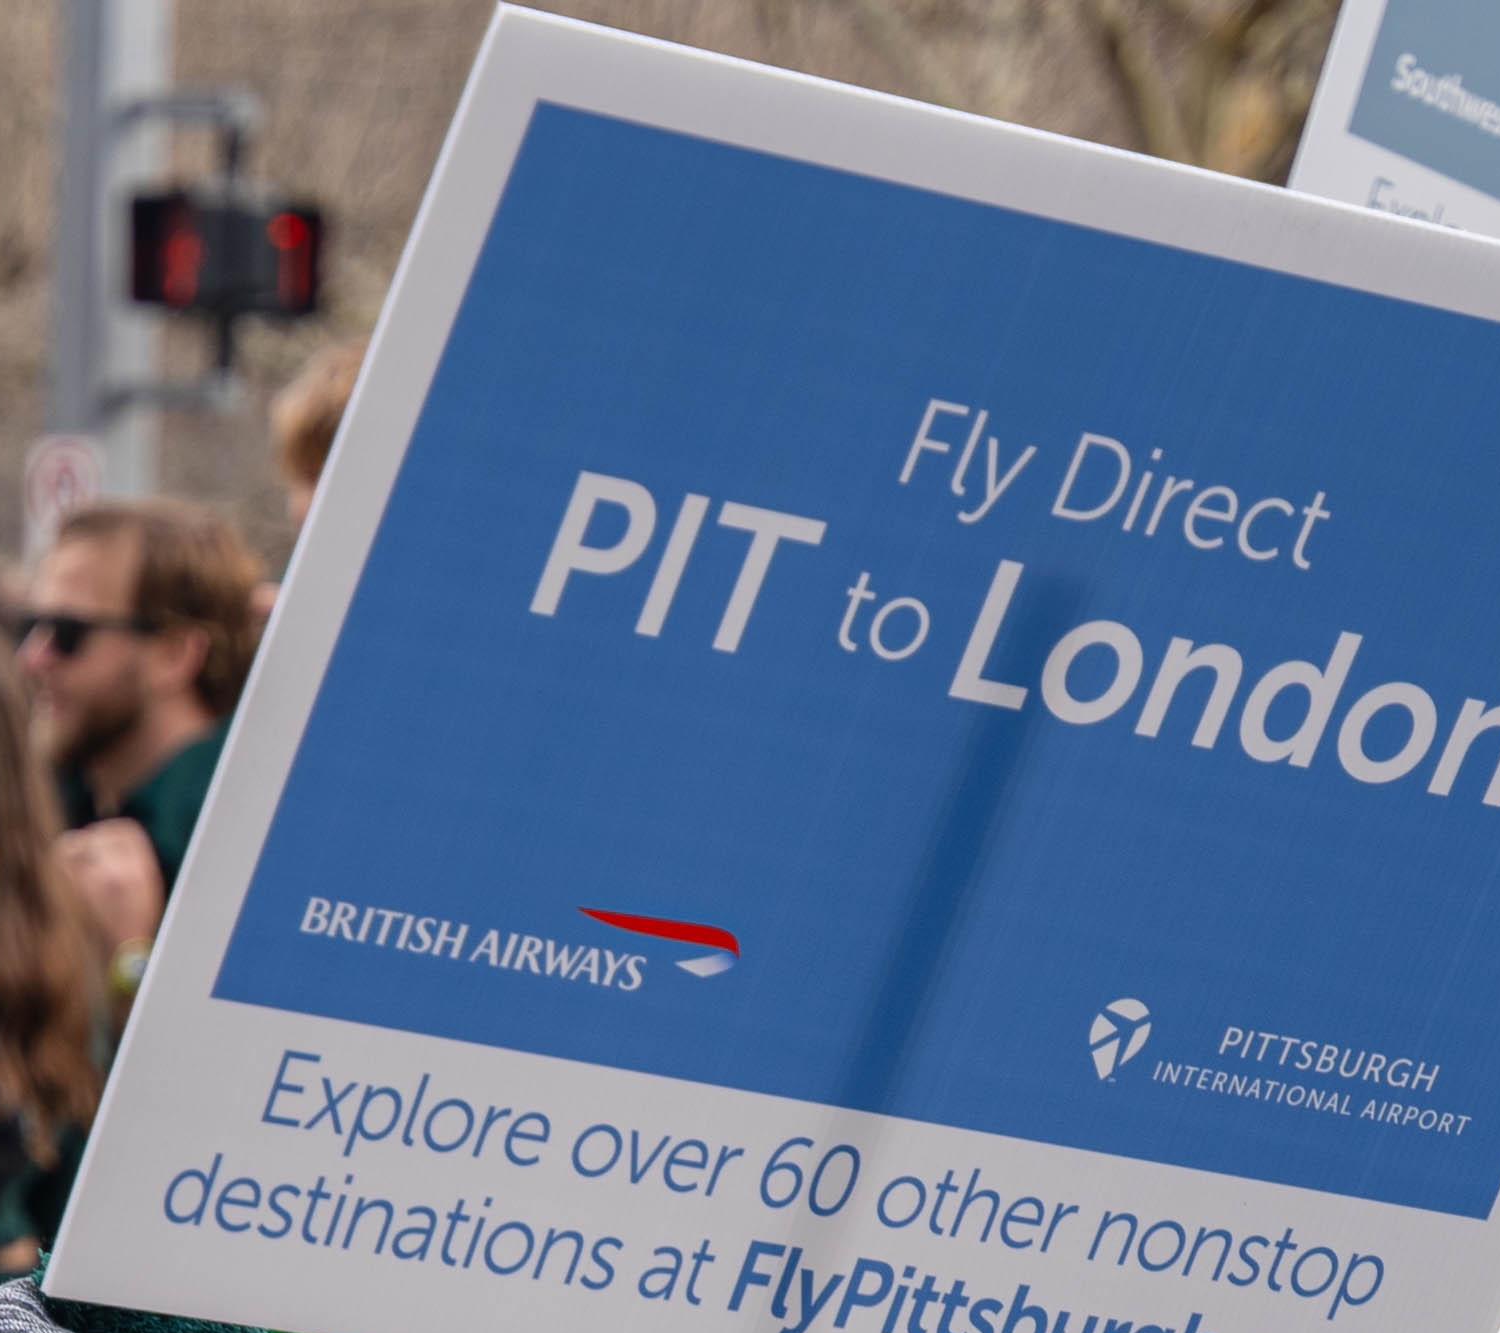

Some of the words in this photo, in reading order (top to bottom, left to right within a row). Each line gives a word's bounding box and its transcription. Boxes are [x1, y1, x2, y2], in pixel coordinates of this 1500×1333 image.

[898, 398, 1037, 524] Fly
[1050, 431, 1332, 570] Direct
[528, 469, 828, 654] PIT
[837, 571, 931, 661] to
[300, 896, 469, 961] BRITISH
[470, 929, 648, 992] AIRWAYS
[1152, 1060, 1354, 1117] INTERNATIONAL
[1360, 1100, 1472, 1138] AIRPORT
[1218, 1025, 1442, 1094] PITTSBURGH
[163, 1152, 624, 1291] destinations
[637, 1238, 715, 1307] at
[261, 1049, 552, 1167] Explore
[570, 1123, 744, 1197] over
[758, 1135, 862, 1218] 60
[876, 1168, 1080, 1254] other
[1087, 1206, 1386, 1321] nonstop
